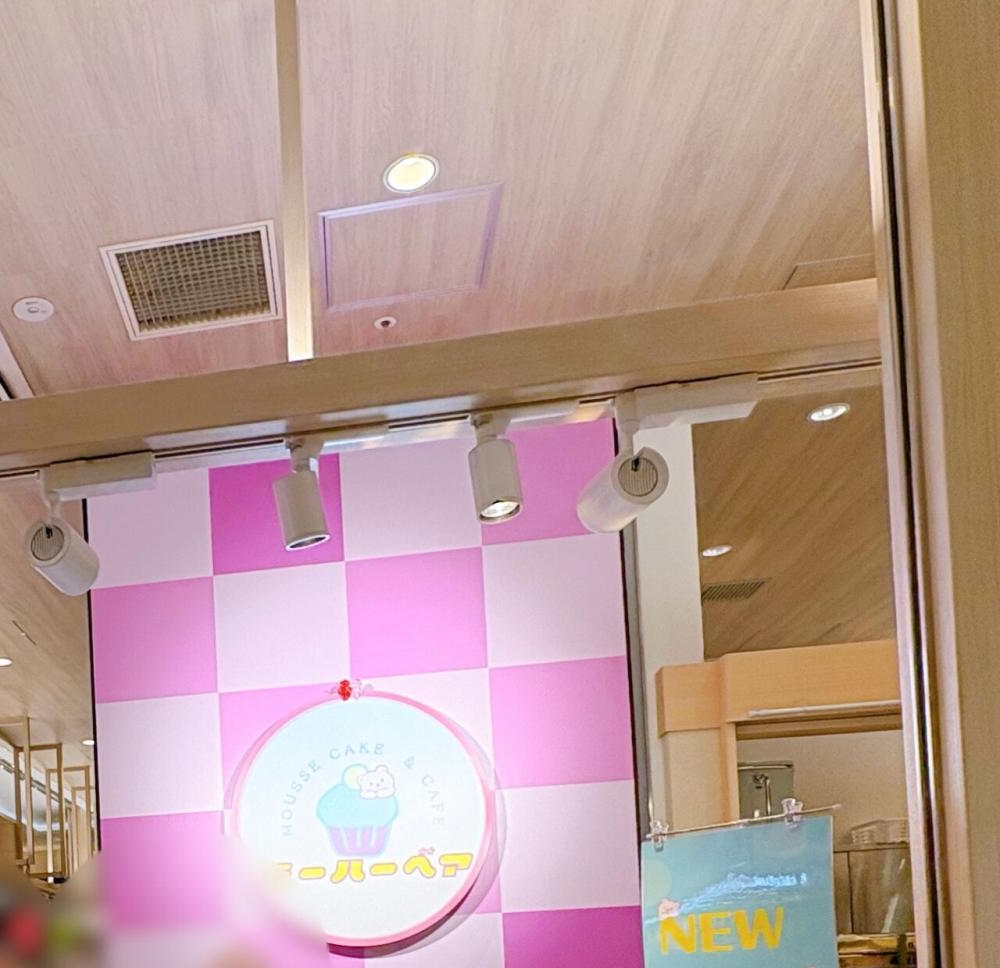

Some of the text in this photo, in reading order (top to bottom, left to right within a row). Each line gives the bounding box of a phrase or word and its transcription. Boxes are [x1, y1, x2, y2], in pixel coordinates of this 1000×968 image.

[281, 759, 321, 837] MOUSSE
[329, 742, 384, 760] CAKE
[422, 775, 445, 826] CAFE
[657, 906, 784, 955] NEW
